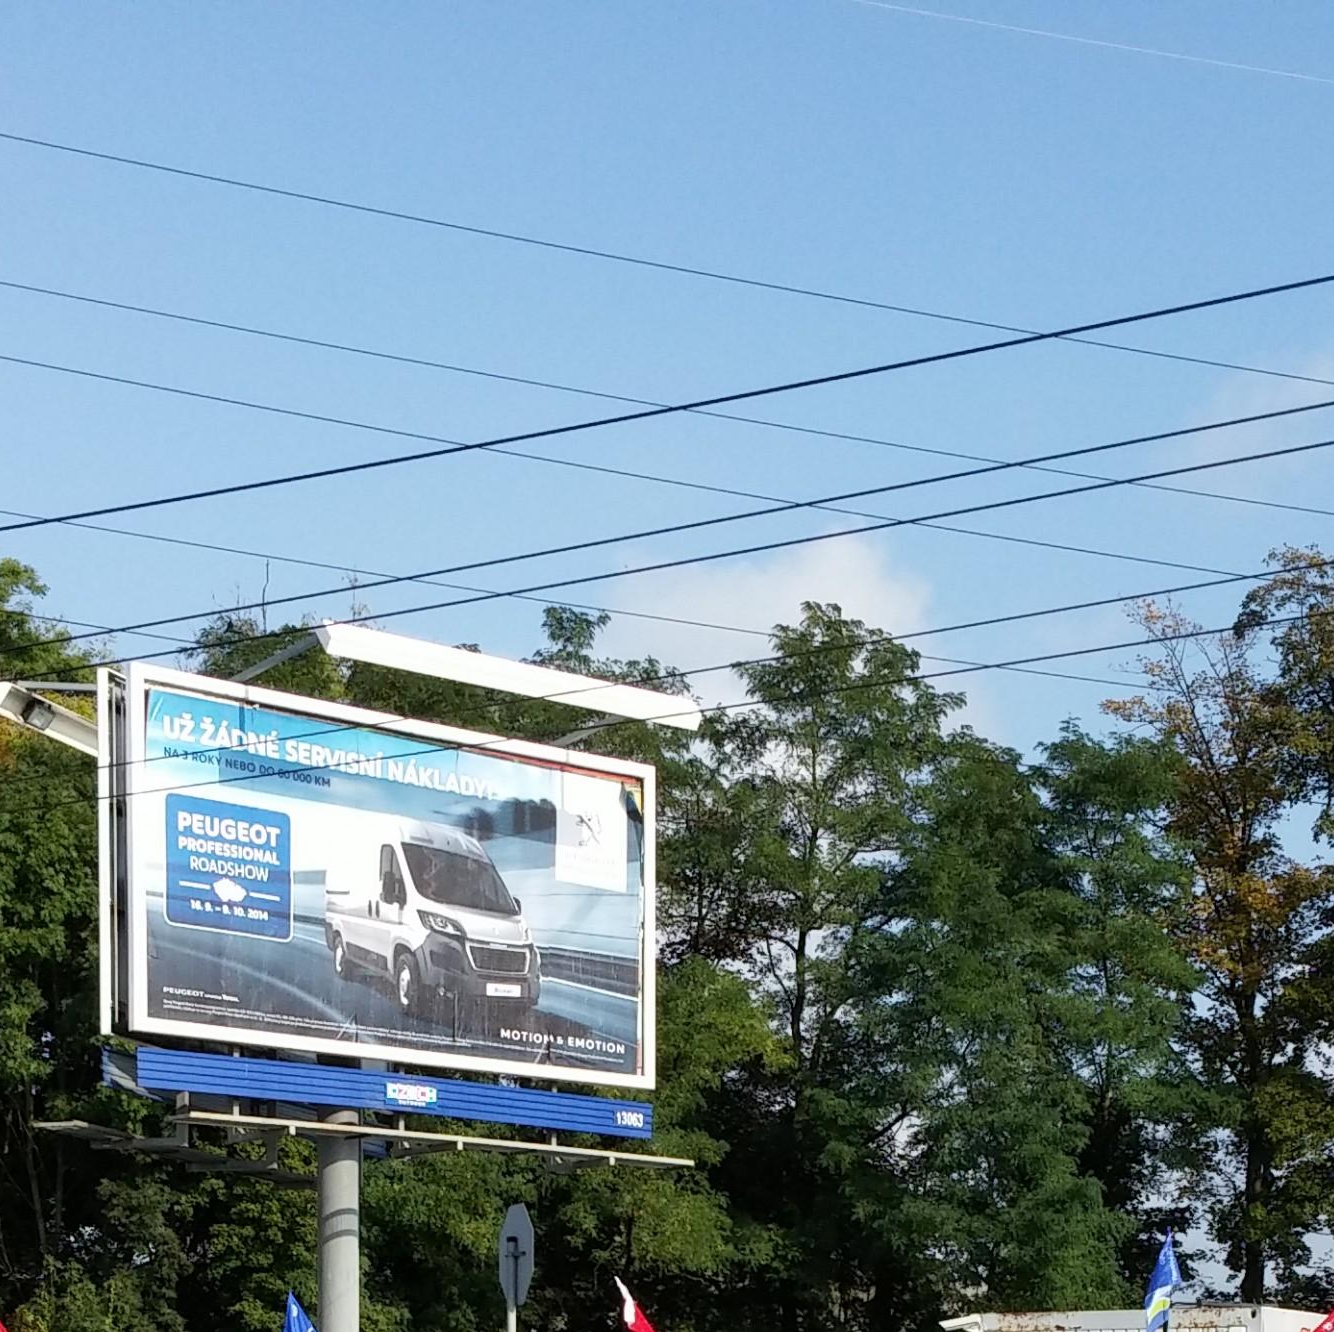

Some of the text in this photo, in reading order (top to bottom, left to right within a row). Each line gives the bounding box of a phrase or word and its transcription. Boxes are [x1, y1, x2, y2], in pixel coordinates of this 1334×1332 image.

[163, 713, 195, 742] UŽ
[200, 716, 280, 759] ŽÁDNÉ
[285, 740, 383, 778] SERVISNÍ
[192, 752, 221, 766] ROKY
[225, 758, 256, 773] NEBO
[259, 764, 275, 776] DO
[314, 776, 331, 788] KM
[177, 811, 281, 847] PEUGEOT
[178, 835, 281, 865] PROFESSIONAL
[189, 856, 269, 882] ROADSHOW
[247, 908, 269, 921] 2014
[163, 986, 204, 998] PEUGEOT
[500, 1028, 553, 1044] MOTION
[567, 1037, 625, 1054] EMOTION
[617, 1111, 644, 1128] 13063
